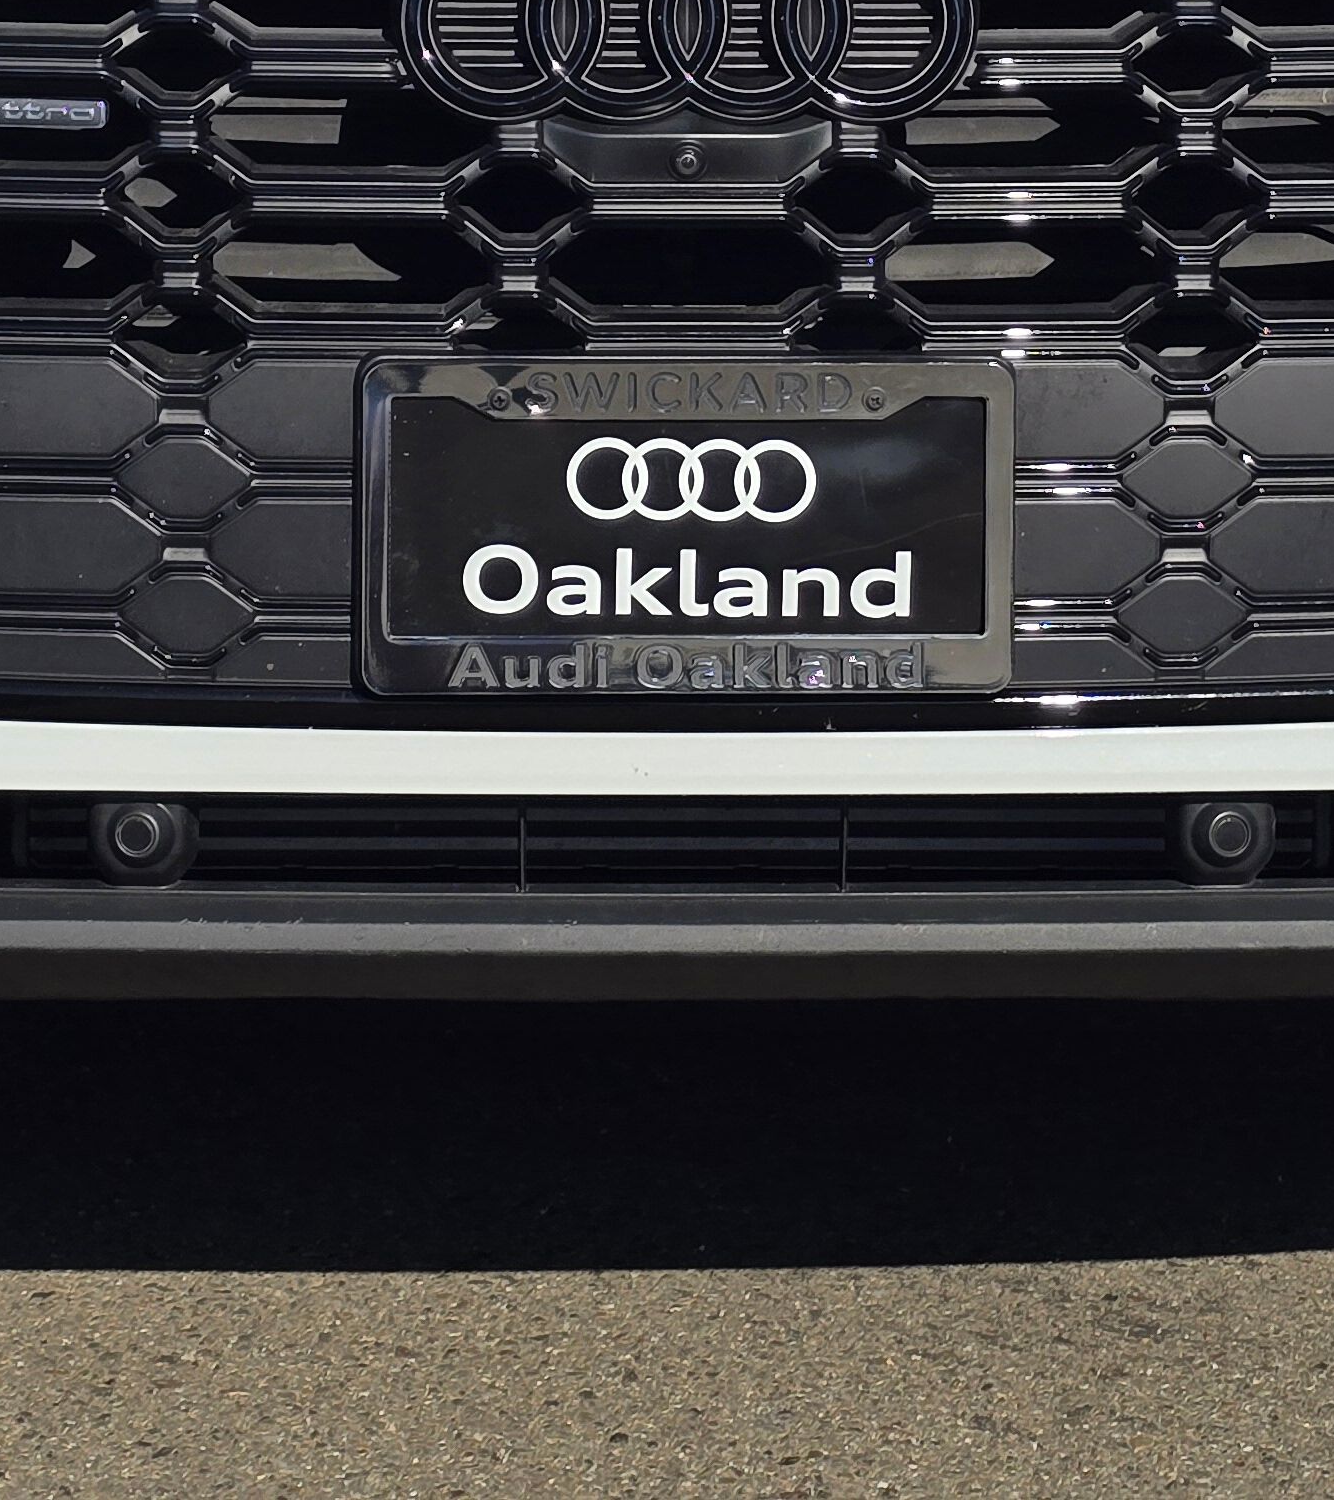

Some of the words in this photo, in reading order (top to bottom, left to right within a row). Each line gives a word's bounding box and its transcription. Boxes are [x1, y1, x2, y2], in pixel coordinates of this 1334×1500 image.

[524, 371, 854, 415] SWICKARD
[462, 543, 914, 619] Oakland
[447, 641, 610, 689] Audi
[634, 641, 926, 690] Oakland
